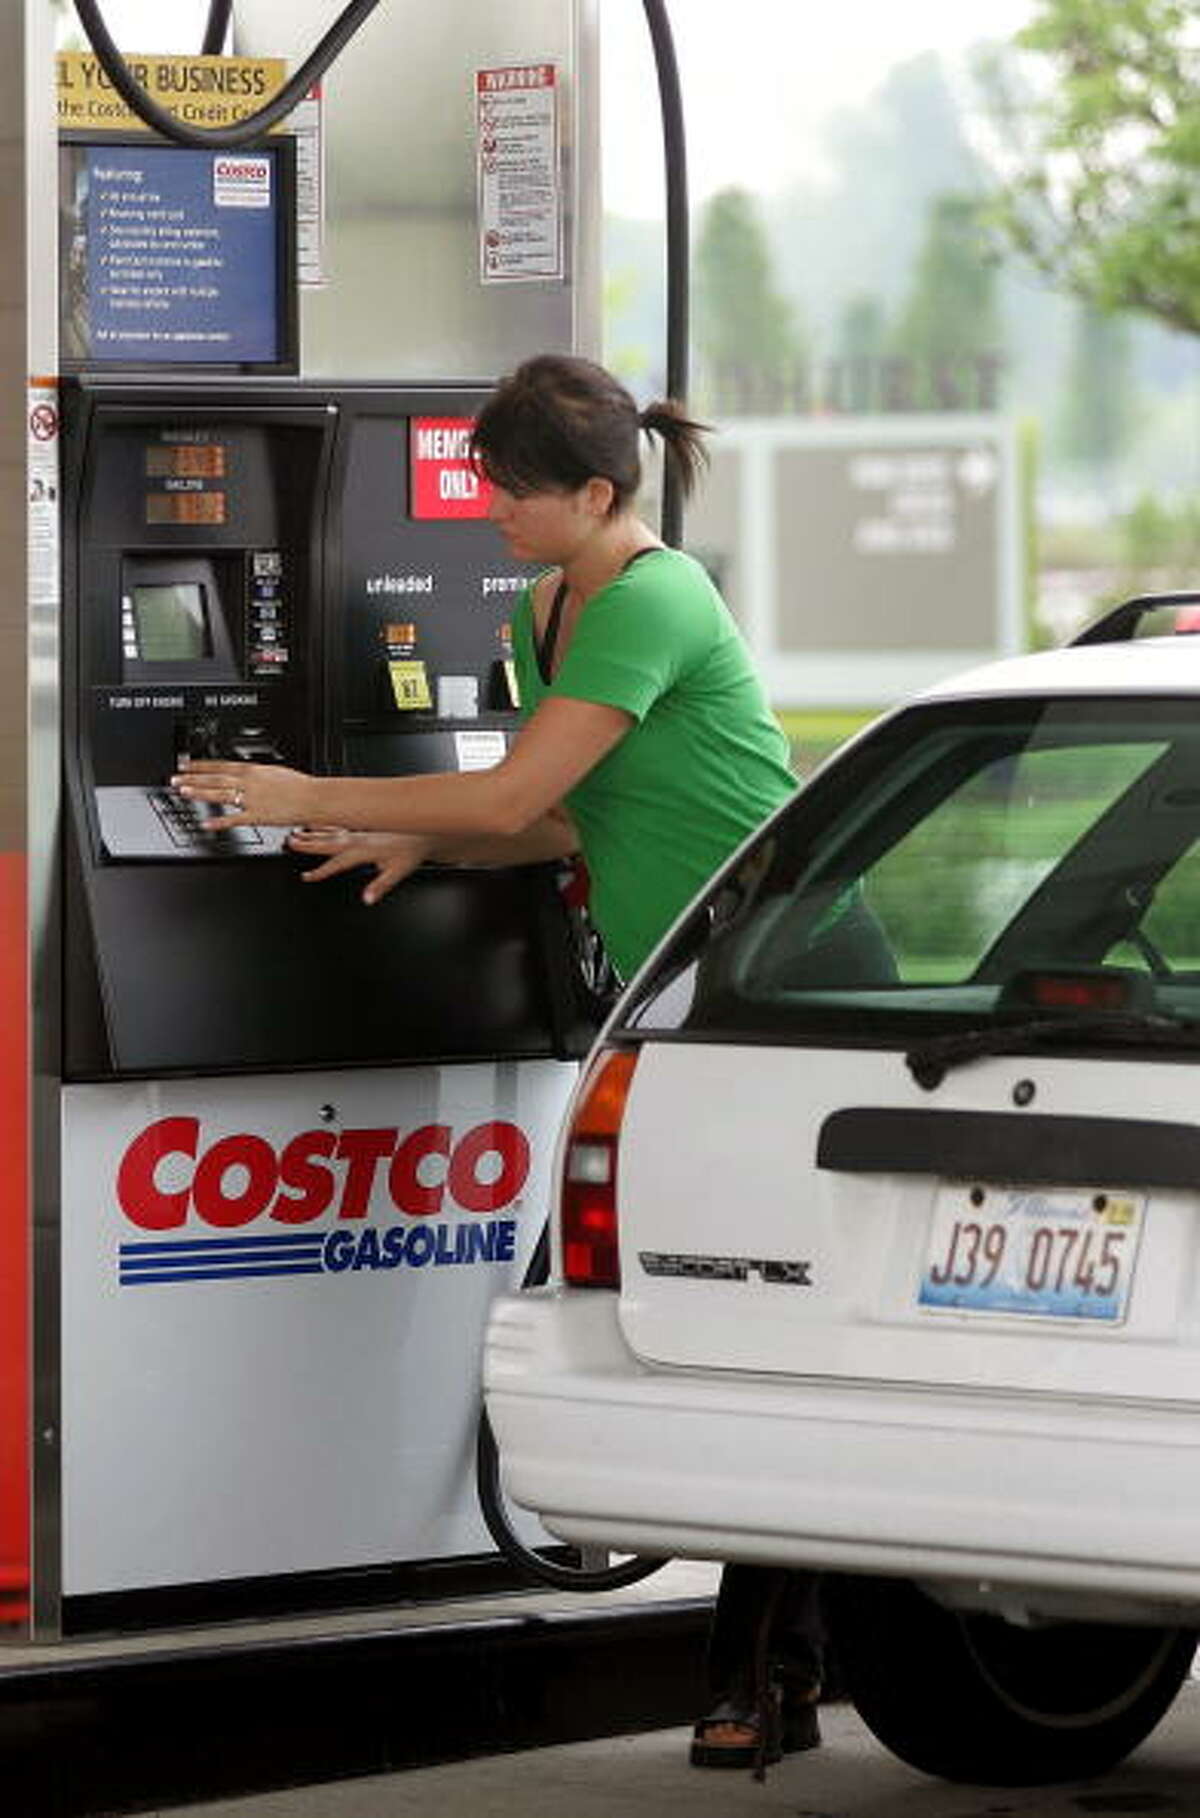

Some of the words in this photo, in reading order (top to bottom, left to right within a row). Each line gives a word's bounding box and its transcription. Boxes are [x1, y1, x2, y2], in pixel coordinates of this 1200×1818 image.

[156, 65, 265, 96] BUSINESS
[440, 469, 479, 499] ONLY
[366, 575, 433, 593] unleaded
[117, 1116, 530, 1231] COSTCO
[322, 1220, 516, 1273] GASOLINE
[929, 1222, 1008, 1289] J39
[1025, 1228, 1127, 1297] 0745
